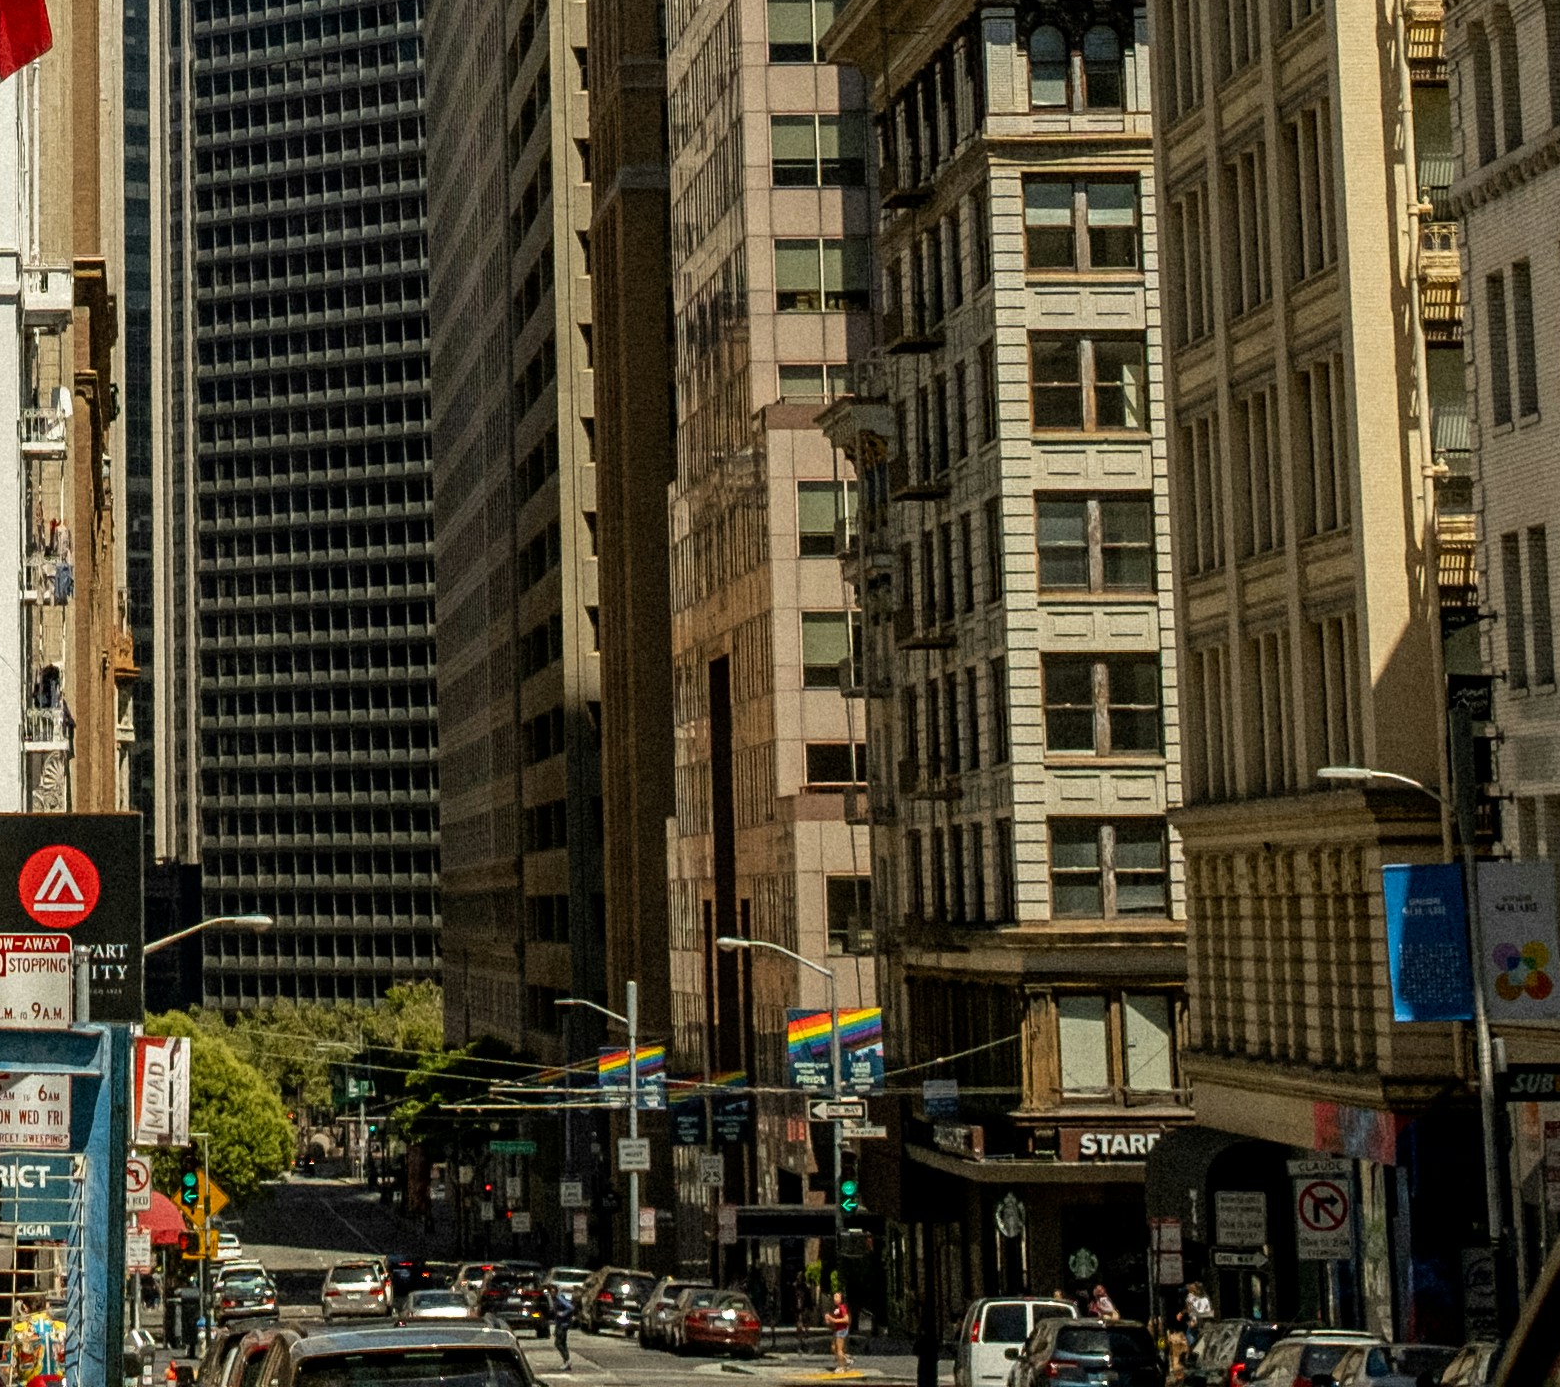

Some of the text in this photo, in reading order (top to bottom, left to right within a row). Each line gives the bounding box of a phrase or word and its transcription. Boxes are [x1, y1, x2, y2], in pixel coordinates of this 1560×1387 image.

[8, 957, 67, 974] STOPPING
[19, 1109, 40, 1125] WED
[47, 1110, 63, 1126] FRI
[23, 1133, 64, 1145] SWEEPING
[1298, 1161, 1344, 1172] CLAUDE
[16, 1225, 51, 1236] CIGAR
